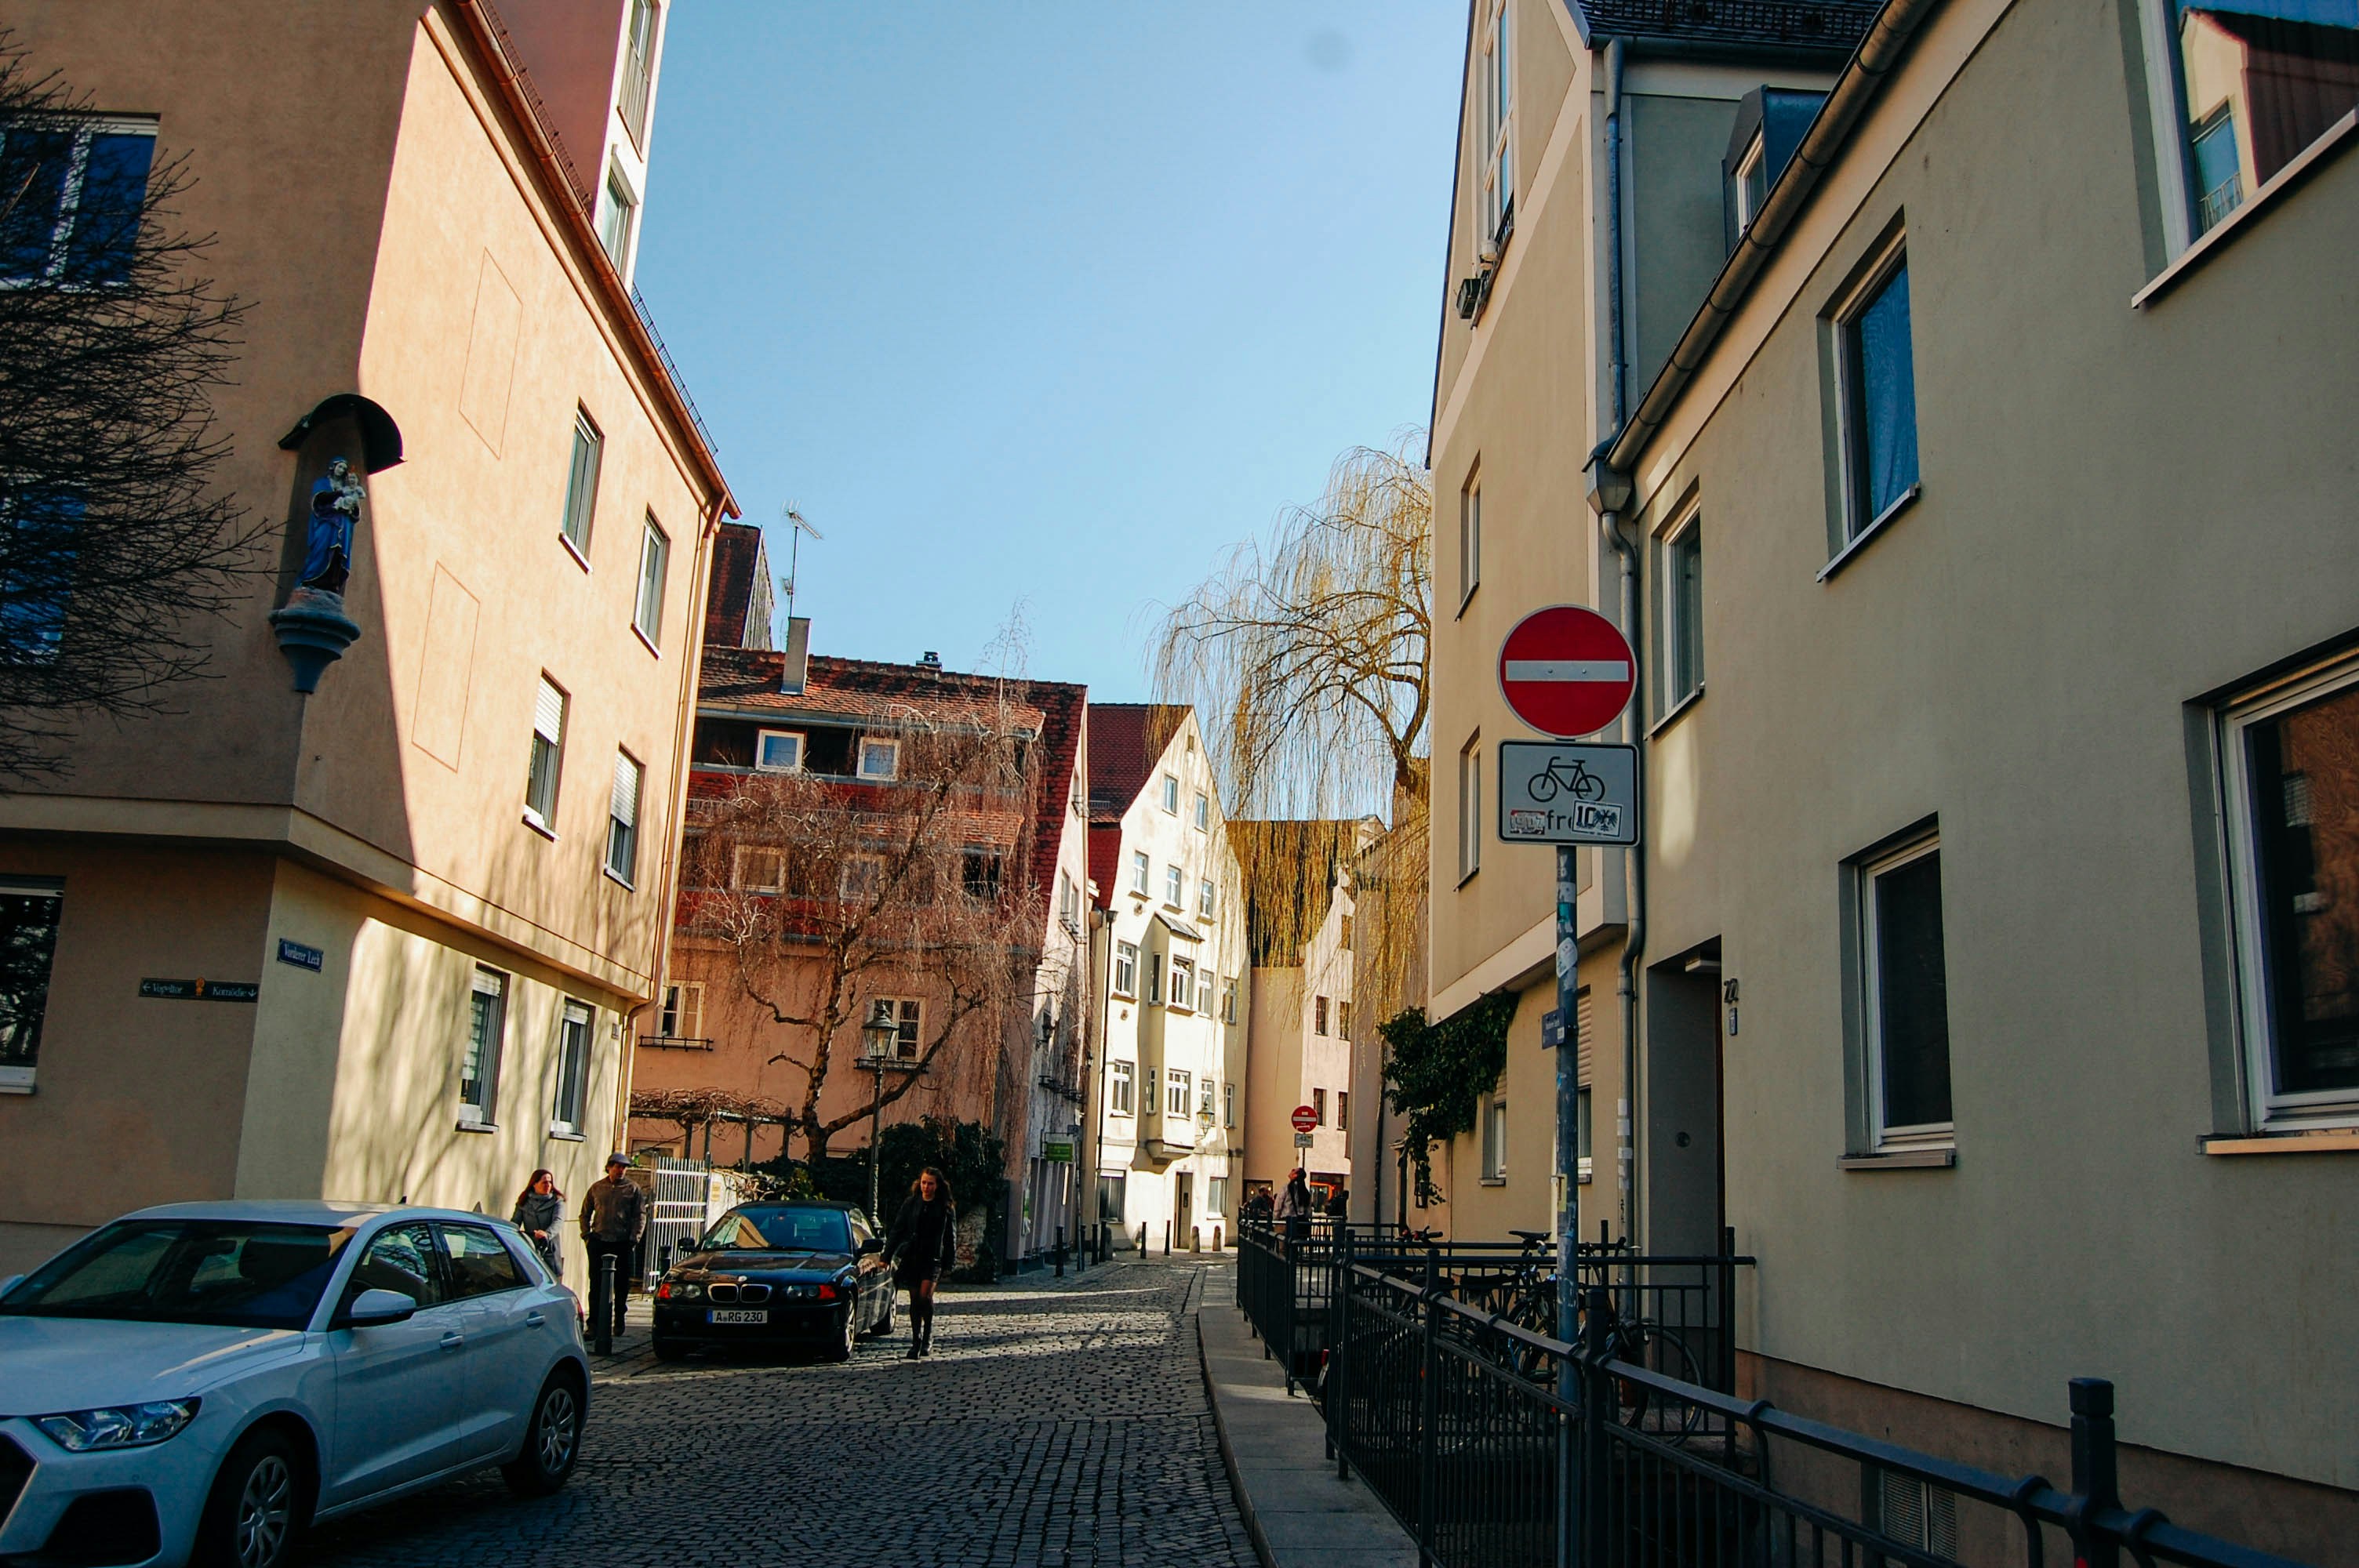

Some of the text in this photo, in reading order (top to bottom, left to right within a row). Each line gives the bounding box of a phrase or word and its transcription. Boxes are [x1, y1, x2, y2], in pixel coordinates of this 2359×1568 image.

[1547, 809, 1572, 830] fr
[307, 950, 320, 966] Lech
[213, 986, 246, 997] Komödie
[728, 1312, 742, 1322] RG
[743, 1312, 763, 1323] 230
